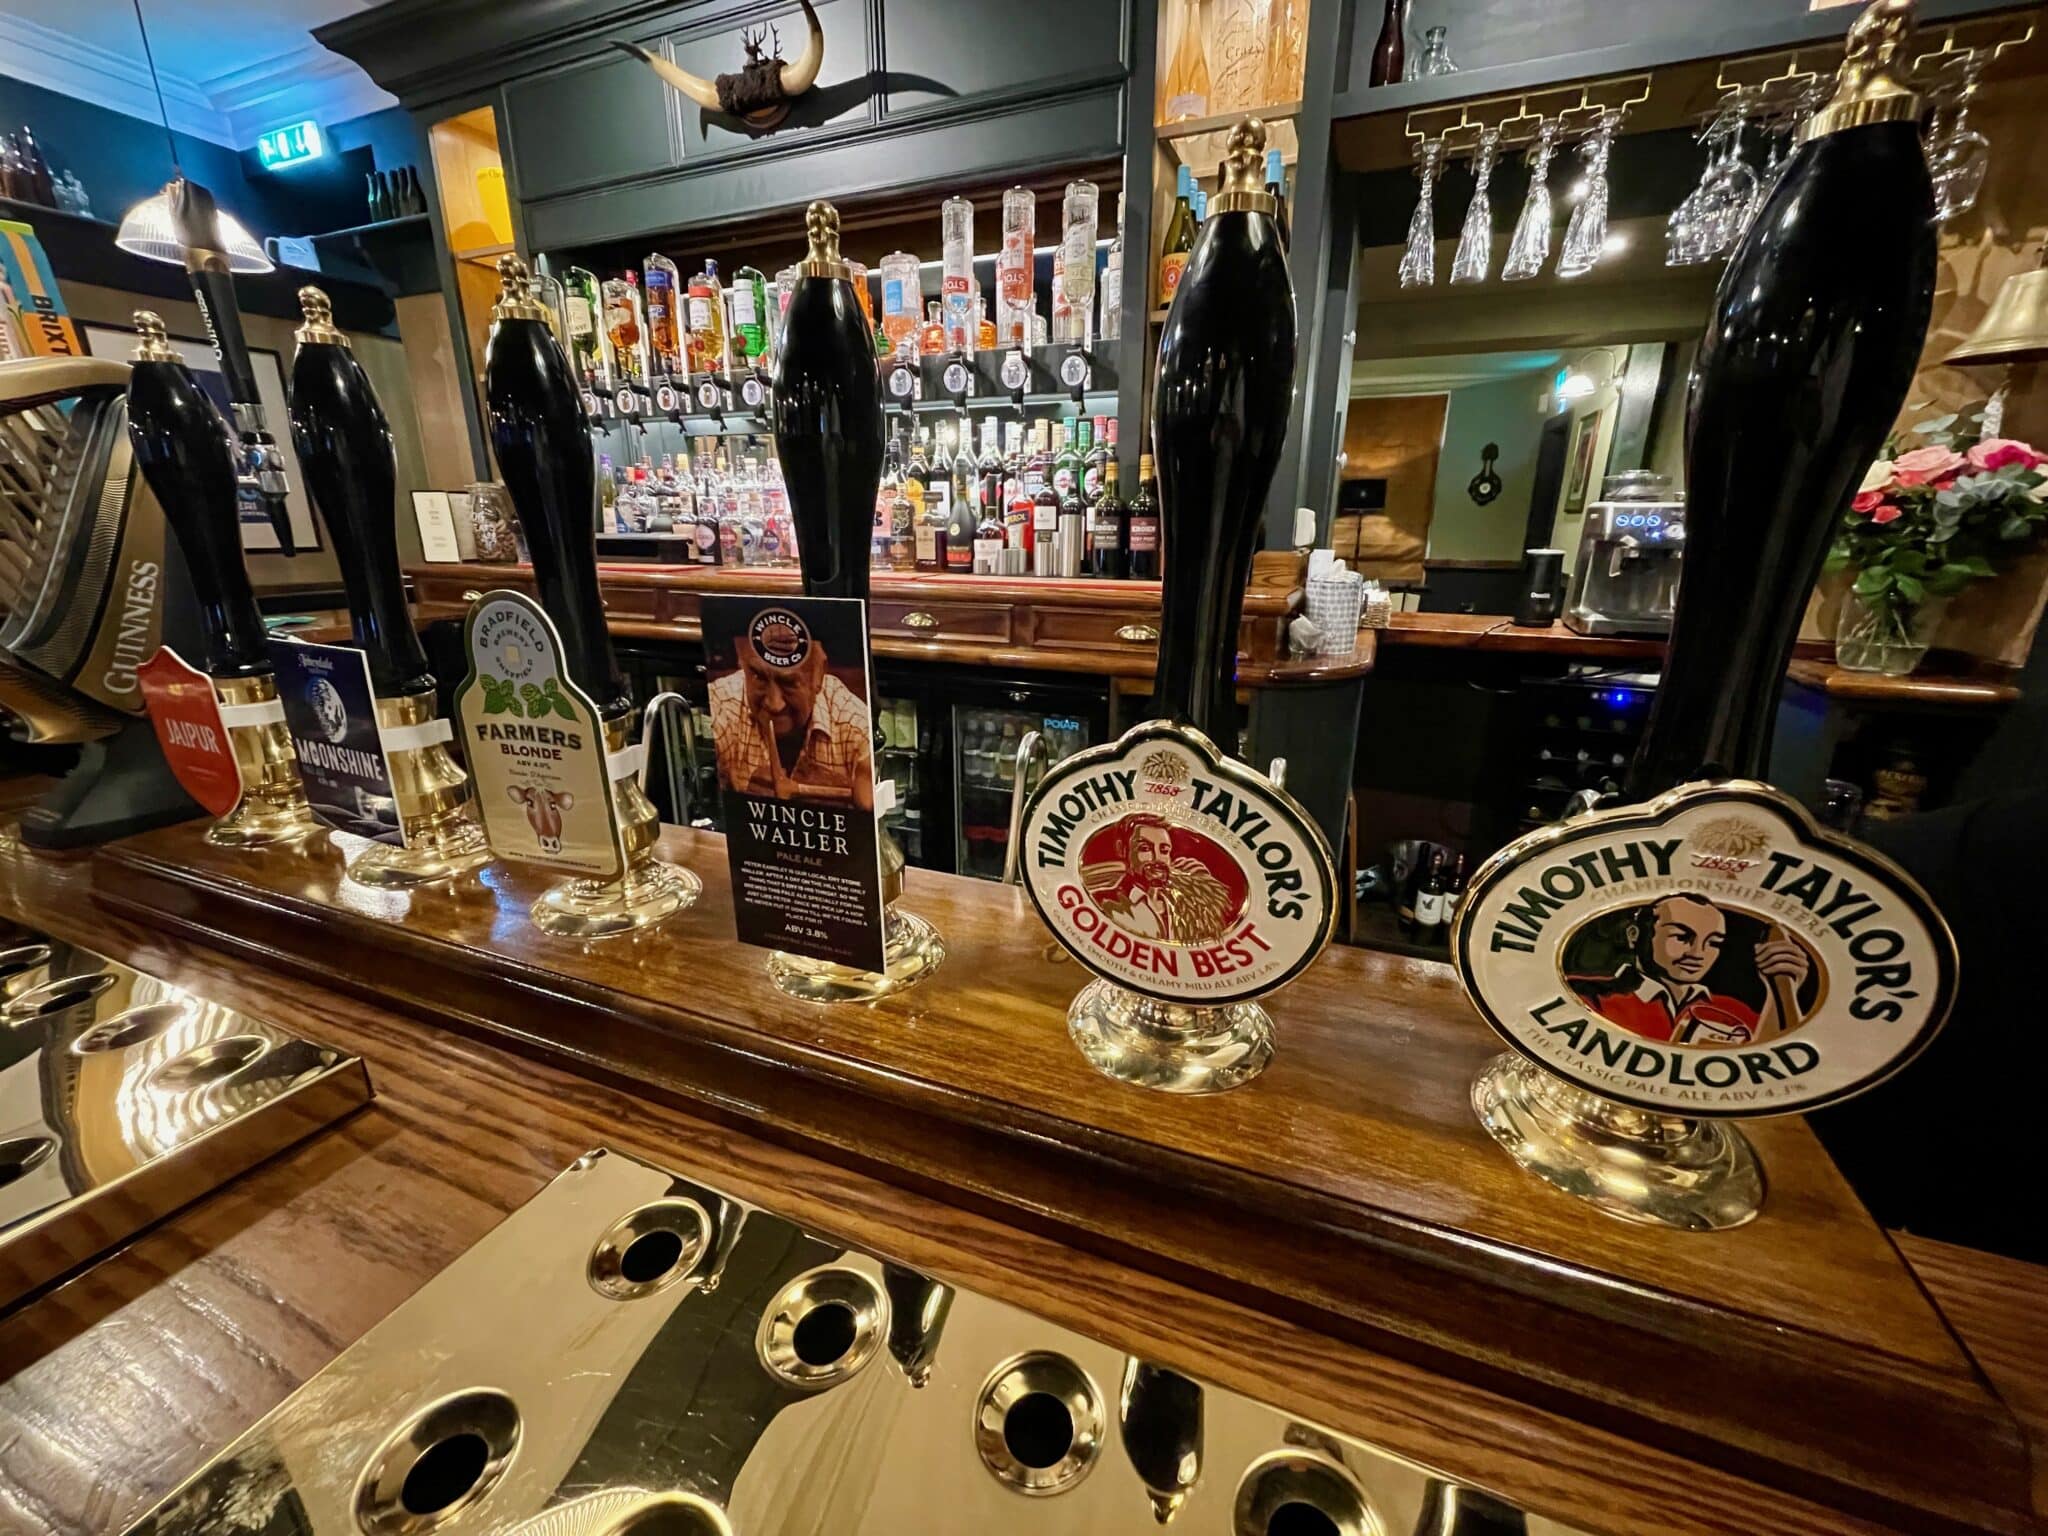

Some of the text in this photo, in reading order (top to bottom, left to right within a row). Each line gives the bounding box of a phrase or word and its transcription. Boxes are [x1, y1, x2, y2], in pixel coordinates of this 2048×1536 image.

[103, 559, 159, 694] GUINNESS
[480, 611, 544, 653] BRADFIELD
[755, 614, 801, 634] WINCLE
[764, 652, 789, 666] BEER
[165, 717, 221, 754] JAIPUR
[475, 723, 582, 750] FARMERS
[1043, 718, 1080, 731] POLAR
[295, 738, 384, 781] MOONSHINE
[500, 743, 563, 760] BLONDE
[1144, 782, 1186, 797] 1858
[747, 800, 847, 832] WINCLE
[748, 822, 849, 855] WALLER
[1038, 770, 1312, 921] TIMOTHY TAYLOR'S
[776, 850, 824, 867] PALE ALE
[1696, 854, 1753, 873] 1858
[1590, 877, 1830, 938] CHAMPIONSHIP BEERS
[784, 923, 804, 935] ABV
[1057, 885, 1272, 978] GOLDEN BEST
[1490, 839, 1919, 1023] TIMOTHY TAYLOR'S
[1529, 996, 1820, 1088] LANDLORD
[1525, 1027, 1553, 1048] THE
[1555, 1048, 1623, 1086] CLASSIC
[1625, 1079, 1669, 1095] PALE
[1677, 1089, 1713, 1101] ALE
[1719, 1090, 1758, 1101] ABV
